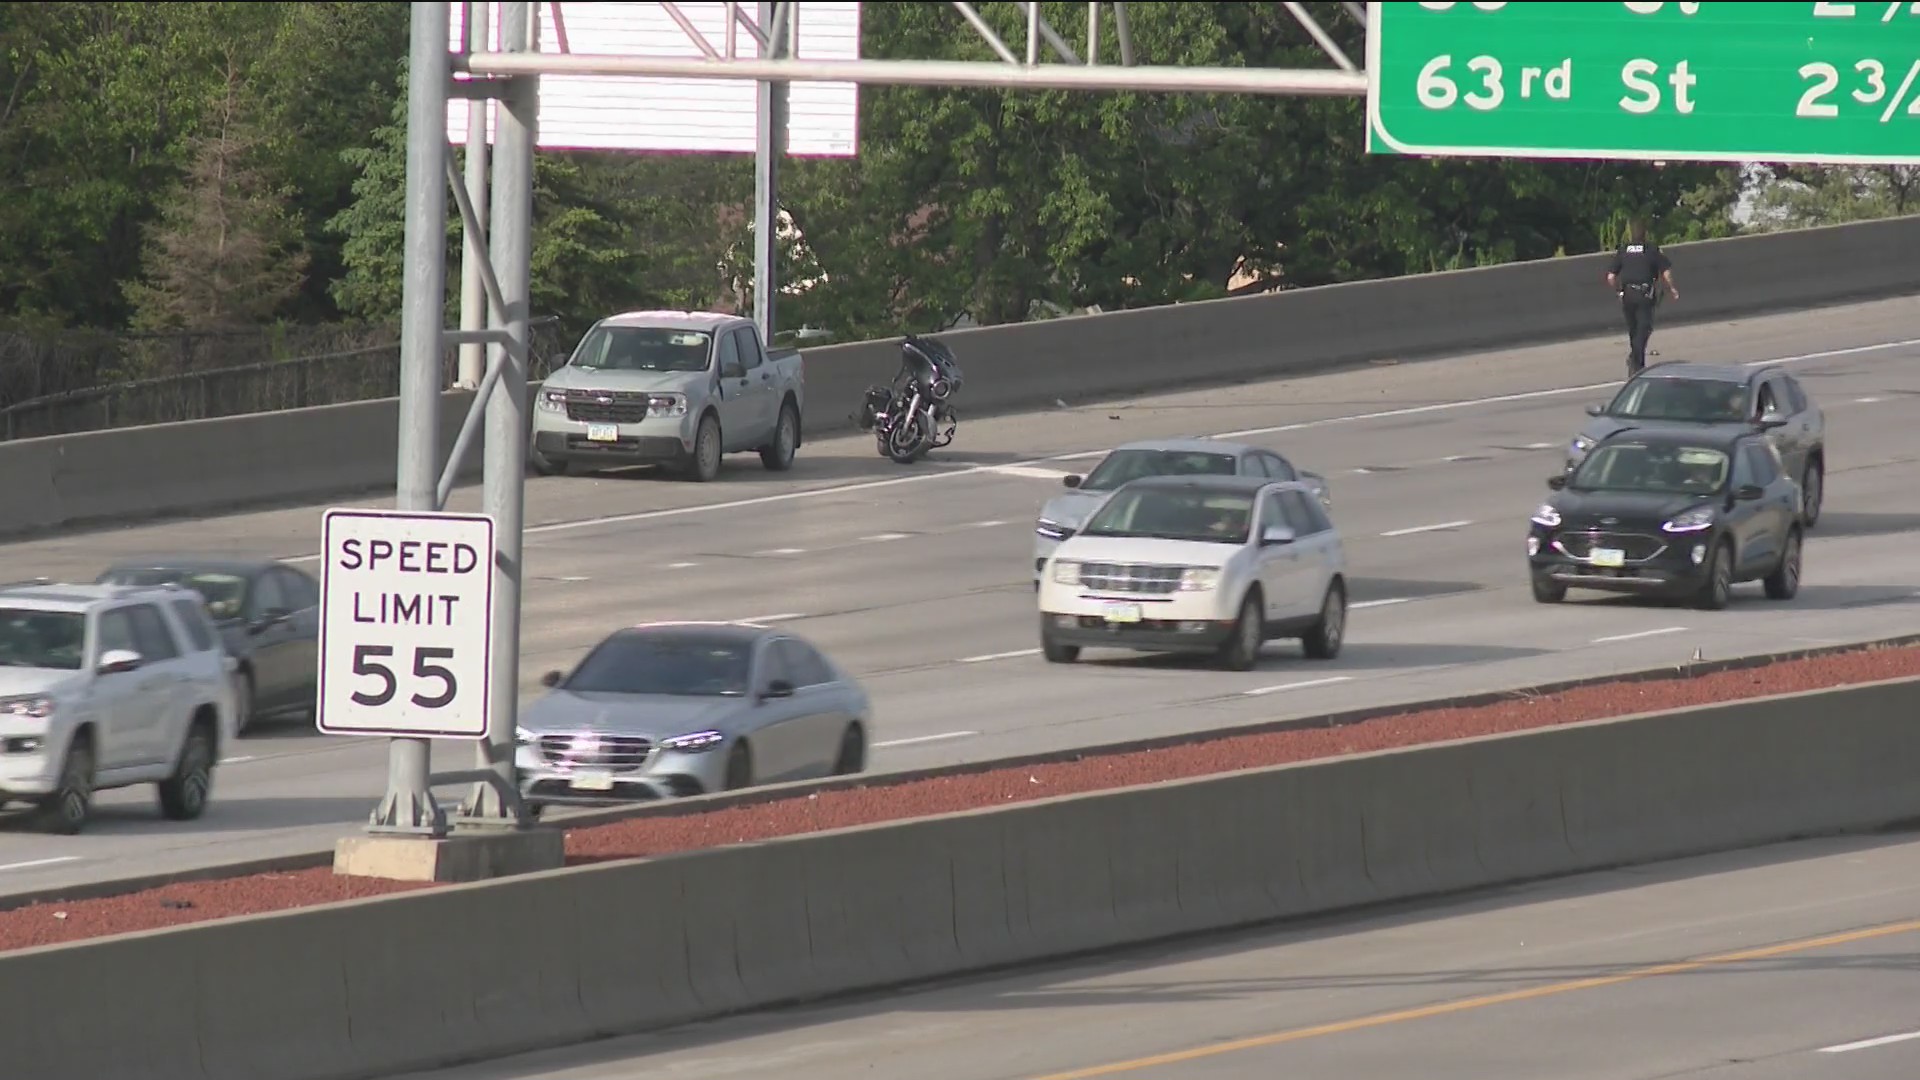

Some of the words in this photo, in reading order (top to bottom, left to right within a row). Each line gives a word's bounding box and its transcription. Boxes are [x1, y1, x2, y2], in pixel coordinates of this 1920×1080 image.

[1618, 58, 1697, 114] St
[340, 538, 478, 574] SPEED
[353, 591, 460, 626] LIMIT
[350, 644, 458, 709] 55
